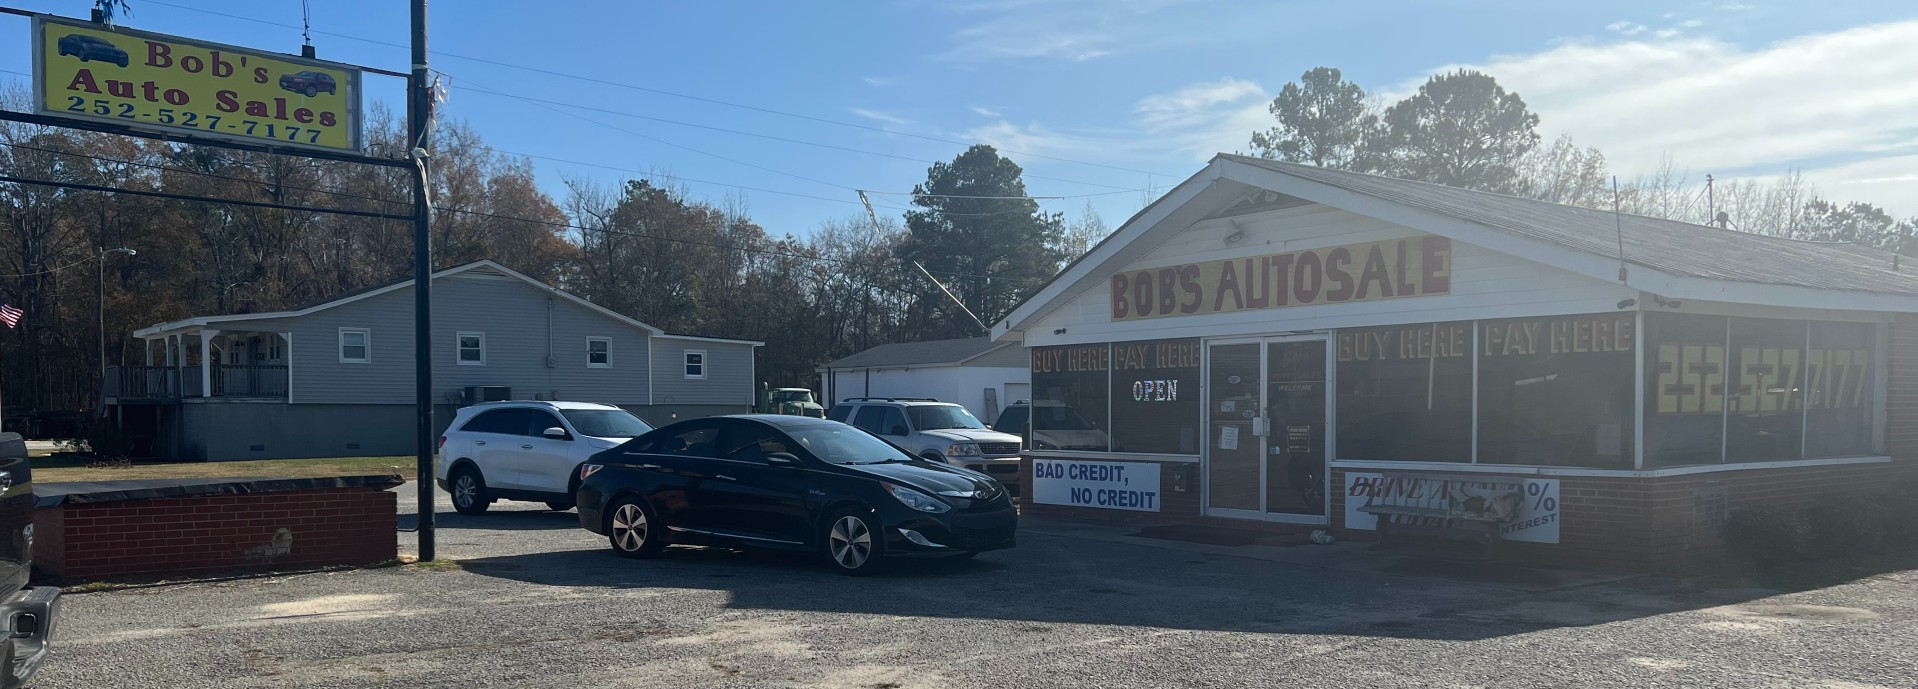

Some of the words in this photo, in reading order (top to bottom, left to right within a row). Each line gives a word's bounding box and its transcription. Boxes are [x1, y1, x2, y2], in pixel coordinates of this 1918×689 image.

[144, 41, 269, 85] Bob's
[67, 68, 190, 106] Auto
[215, 89, 338, 128] Sales
[67, 95, 322, 144] 252-527-7177
[1112, 263, 1203, 319] BOB'S
[1213, 236, 1450, 312] AUTOSALE
[1337, 329, 1392, 362] BUY
[1399, 325, 1465, 360] HERE
[1485, 321, 1544, 356] PAY
[1551, 317, 1634, 354] HERE
[1033, 349, 1065, 373] BUY
[1068, 346, 1108, 372] HERE
[1114, 343, 1150, 370] PAY
[1156, 341, 1200, 369] HERE
[1132, 379, 1178, 402] OPEN
[1035, 462, 1064, 479] BAD
[1069, 464, 1129, 487] CREDIT,
[1348, 476, 1428, 500] DRIVE
[1070, 487, 1093, 504] NO
[1097, 489, 1156, 509] CREDIT
[1501, 513, 1557, 535] NTEREST
